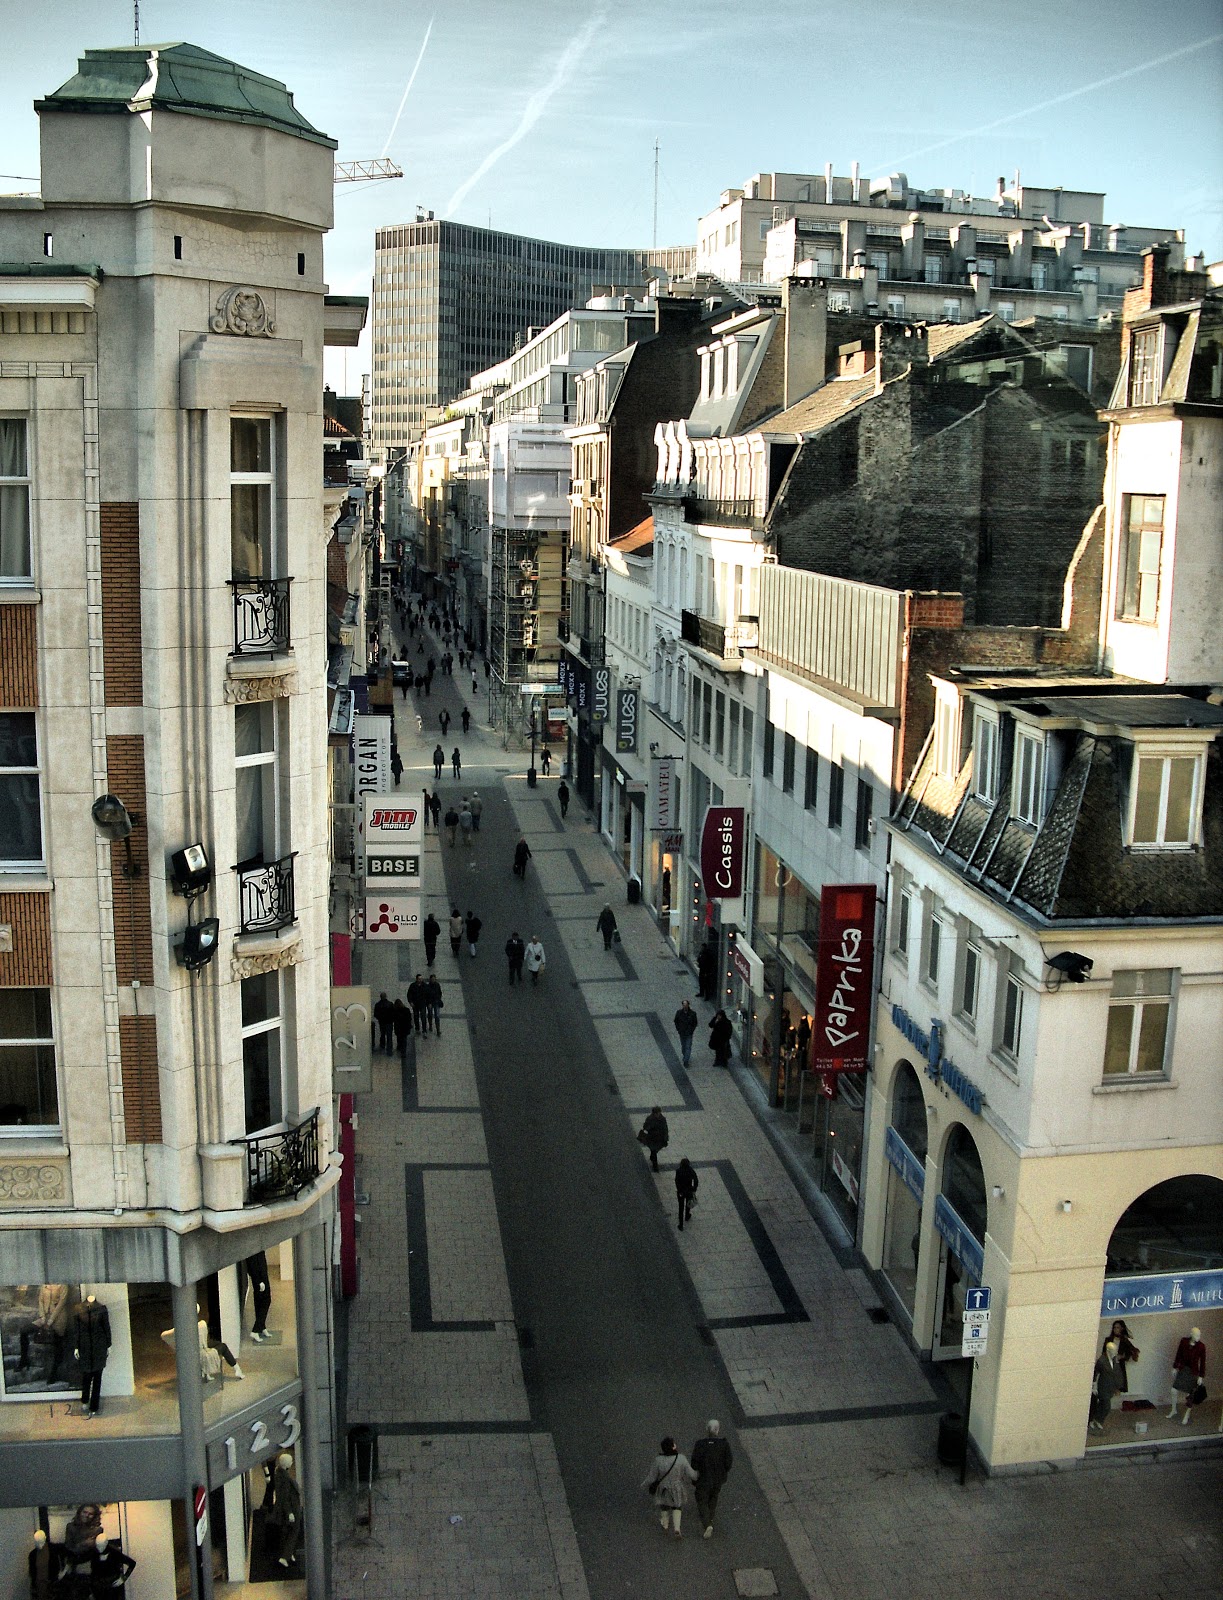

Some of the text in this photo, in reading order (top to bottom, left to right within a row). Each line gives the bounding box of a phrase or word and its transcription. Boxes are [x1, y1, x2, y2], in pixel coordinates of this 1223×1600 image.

[621, 693, 635, 747] JULES
[358, 738, 378, 797] ORGAN
[371, 860, 415, 873] BASE
[715, 816, 733, 889] Cassis
[824, 928, 863, 1047] Paprika
[1106, 1298, 1127, 1311] UN
[1131, 1295, 1165, 1309] JOUR
